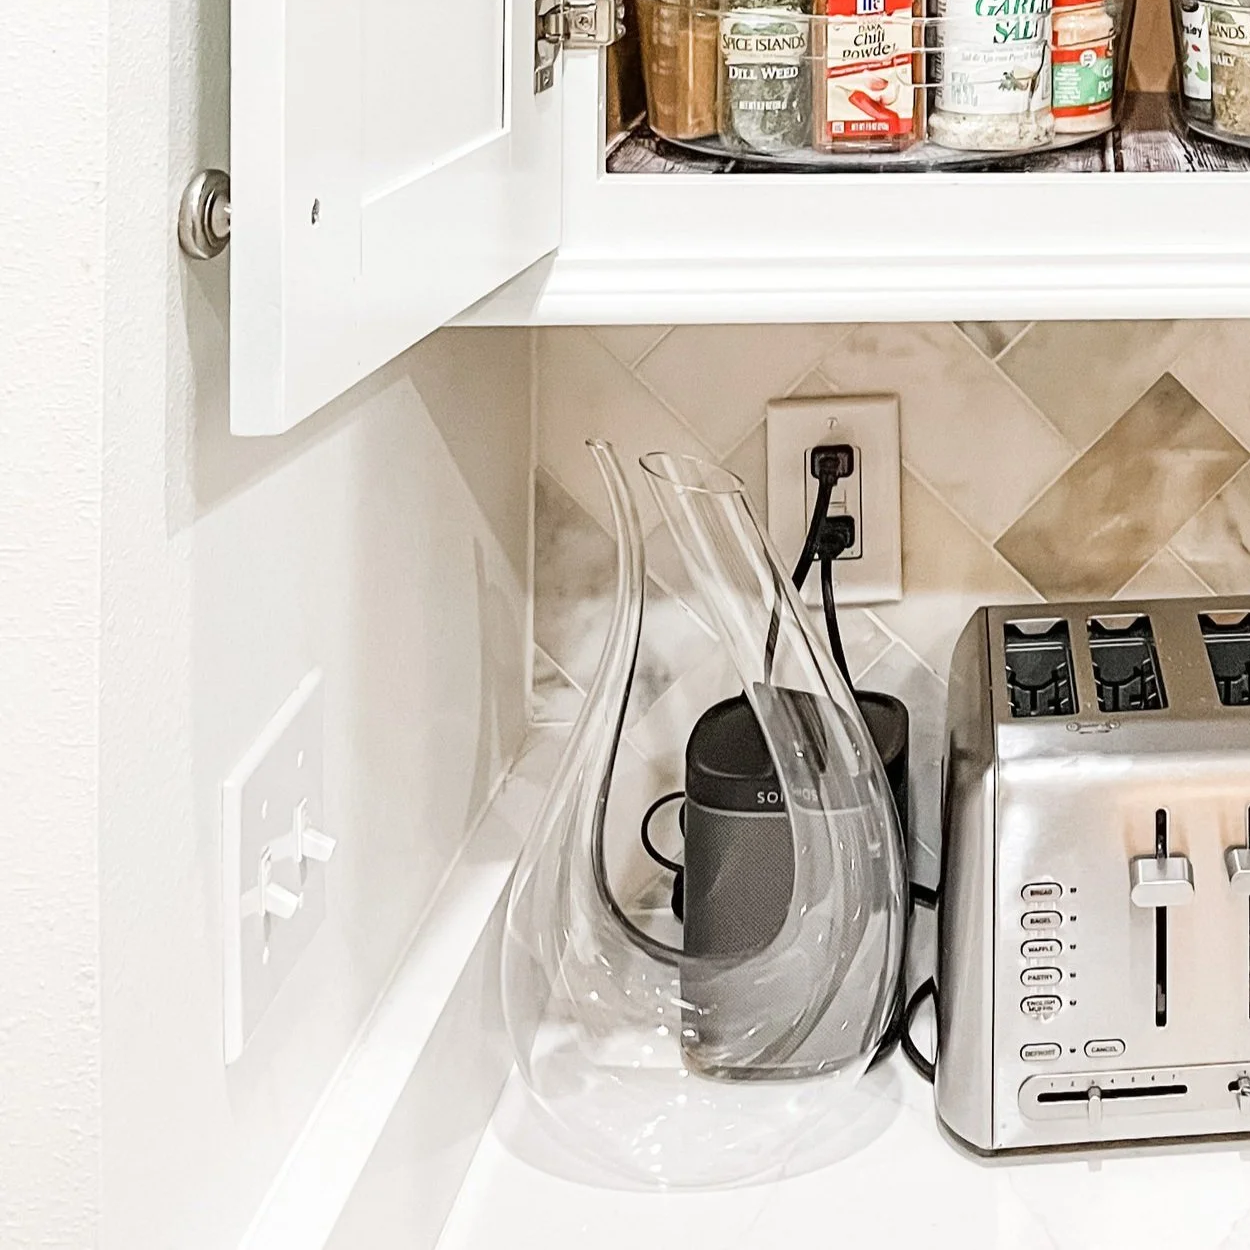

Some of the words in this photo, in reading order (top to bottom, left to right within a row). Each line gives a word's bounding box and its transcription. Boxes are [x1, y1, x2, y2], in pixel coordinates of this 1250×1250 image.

[993, 17, 1039, 44] SALT
[722, 33, 753, 51] SPICE
[755, 32, 806, 52] ISLANDS
[853, 29, 886, 47] Chili
[728, 65, 758, 80] DILL
[760, 65, 799, 81] WEED
[1030, 917, 1052, 925] BAGEL
[1028, 945, 1053, 953] WAFFLE
[1027, 973, 1053, 981] PASTRY
[1026, 999, 1056, 1007] ENGLISH
[1091, 1045, 1118, 1053] CANCEL
